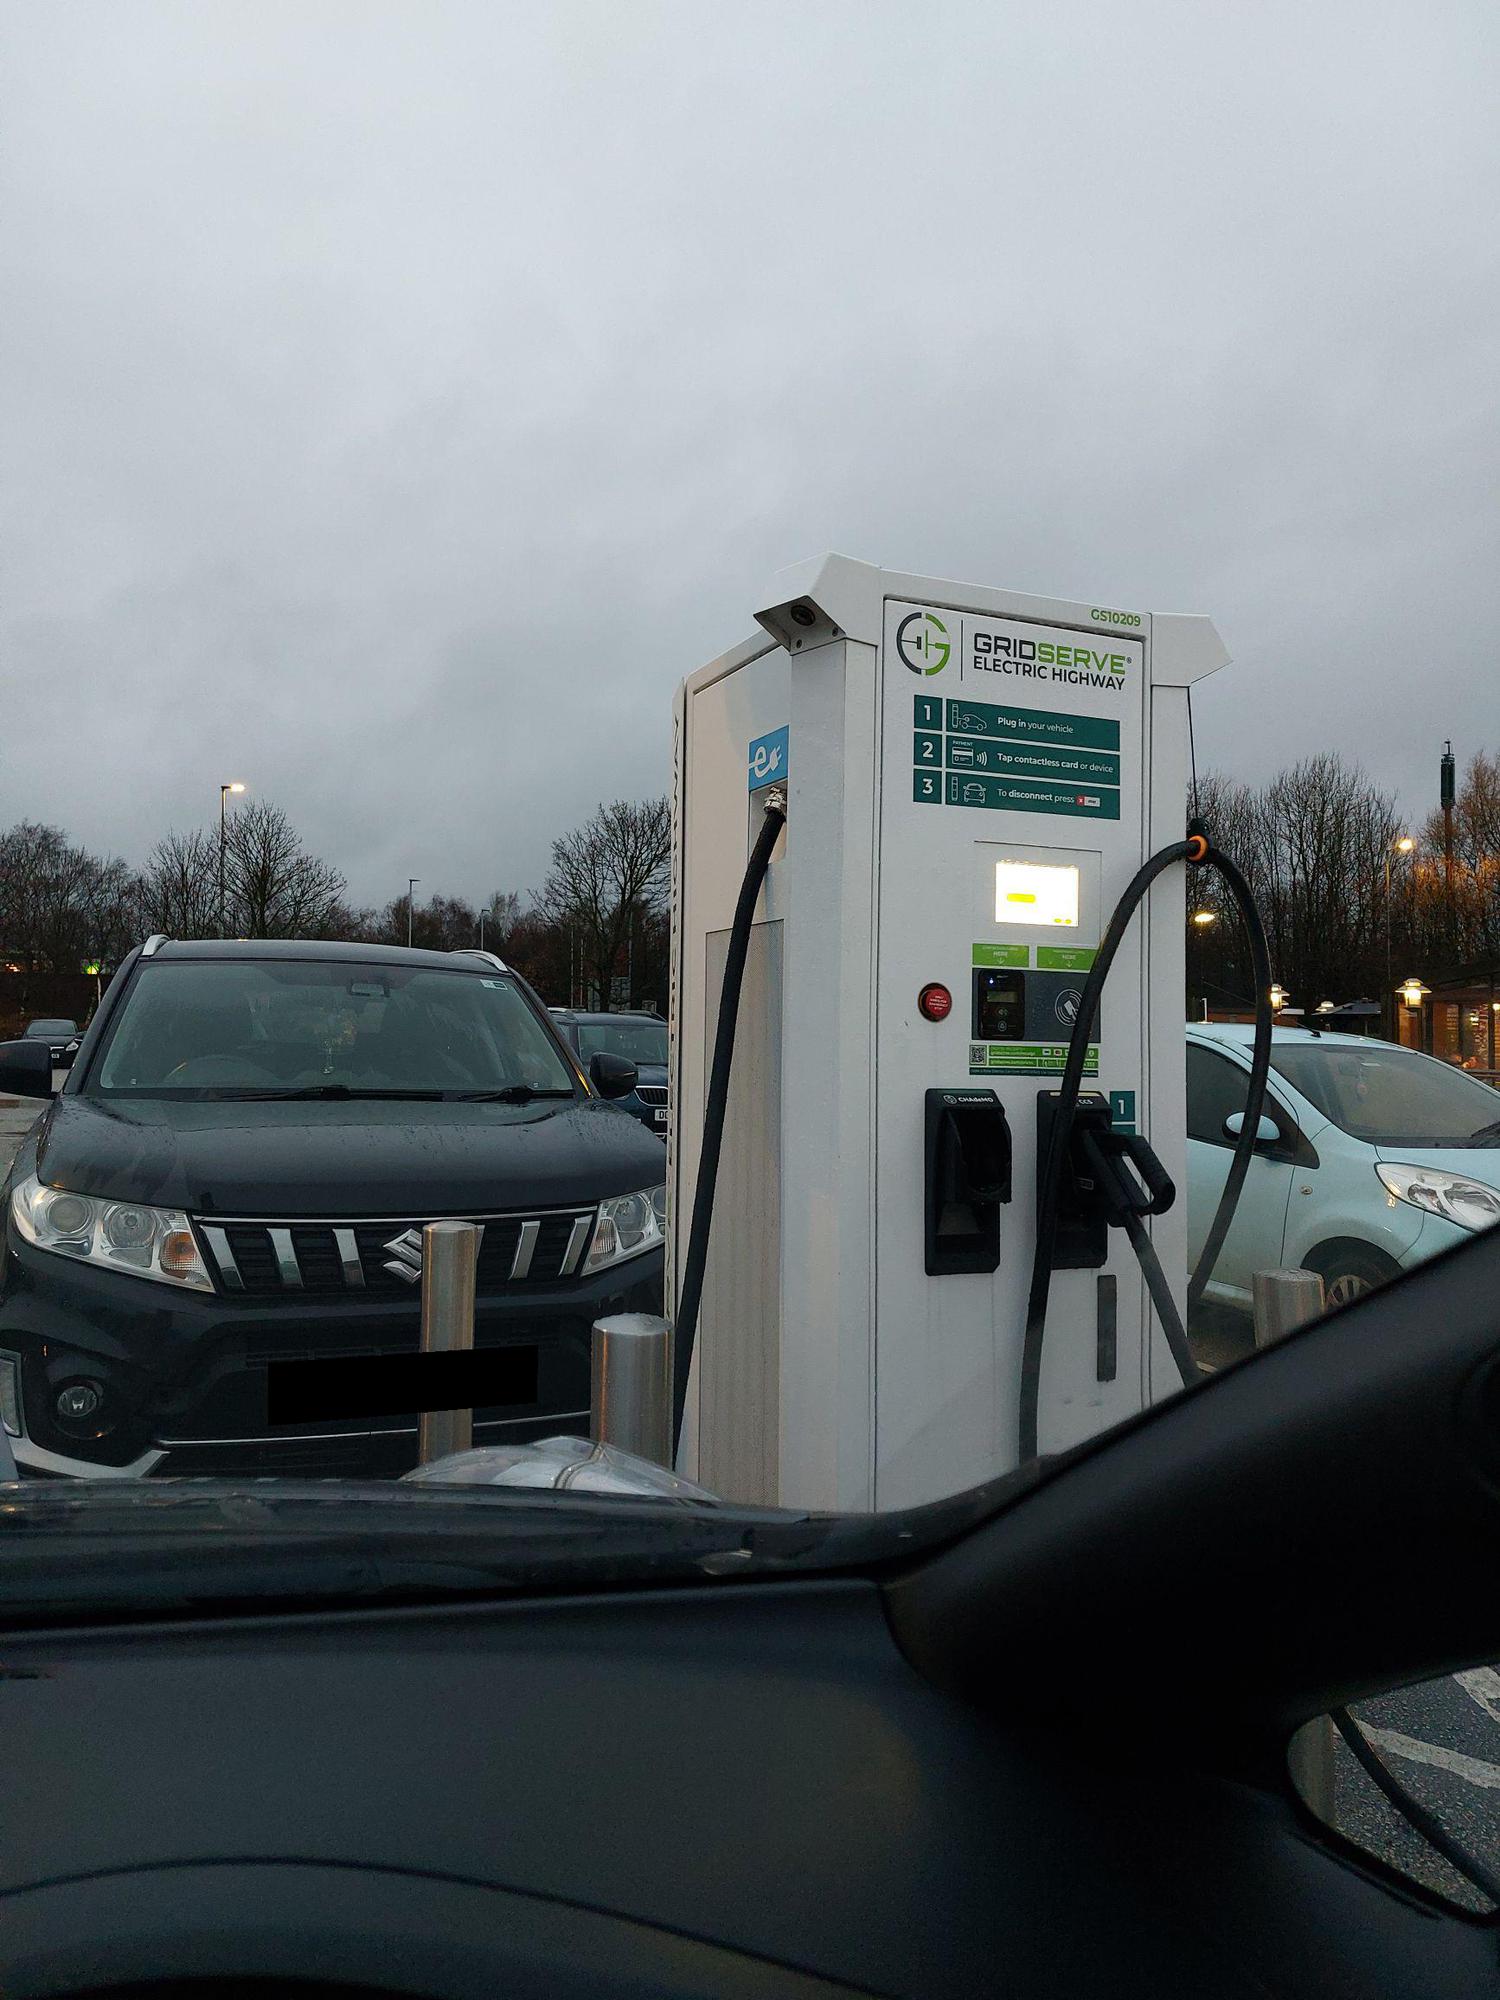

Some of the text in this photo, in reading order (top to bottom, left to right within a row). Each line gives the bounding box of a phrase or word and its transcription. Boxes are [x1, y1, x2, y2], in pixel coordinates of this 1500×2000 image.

[1090, 608, 1141, 627] GS10209
[973, 656, 1125, 690] ELECTRIC HIGHWAY
[923, 704, 1074, 734] 1 Plug in your vehicle
[922, 741, 1114, 774] 2 Tap contactless card or device
[921, 778, 1075, 806] 3 To disconnect press
[1117, 1099, 1126, 1114] 1
